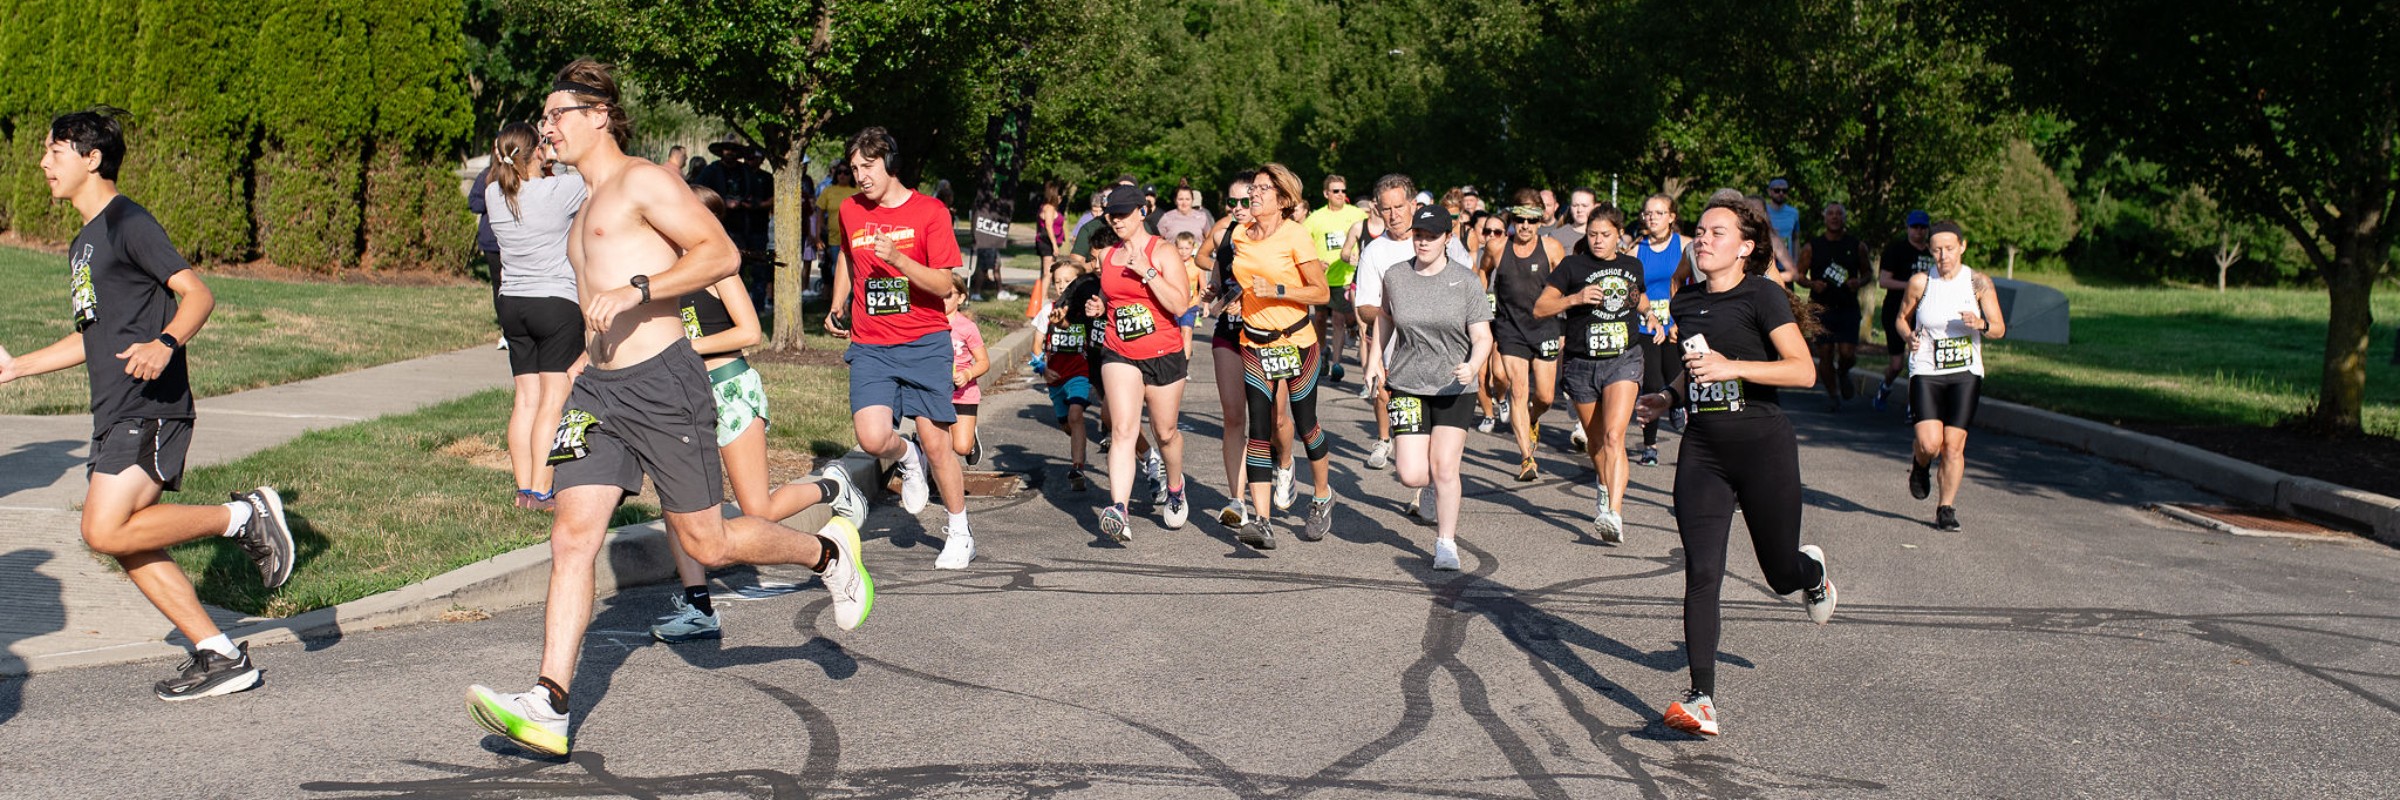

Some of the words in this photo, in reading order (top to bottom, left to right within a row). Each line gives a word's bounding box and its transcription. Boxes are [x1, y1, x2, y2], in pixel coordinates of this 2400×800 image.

[976, 217, 1008, 235] GCXC
[868, 280, 903, 289] GCXC
[867, 291, 907, 306] 6270
[1051, 333, 1084, 346] 6284
[1262, 356, 1300, 371] 6302
[1690, 380, 1740, 402] 6289
